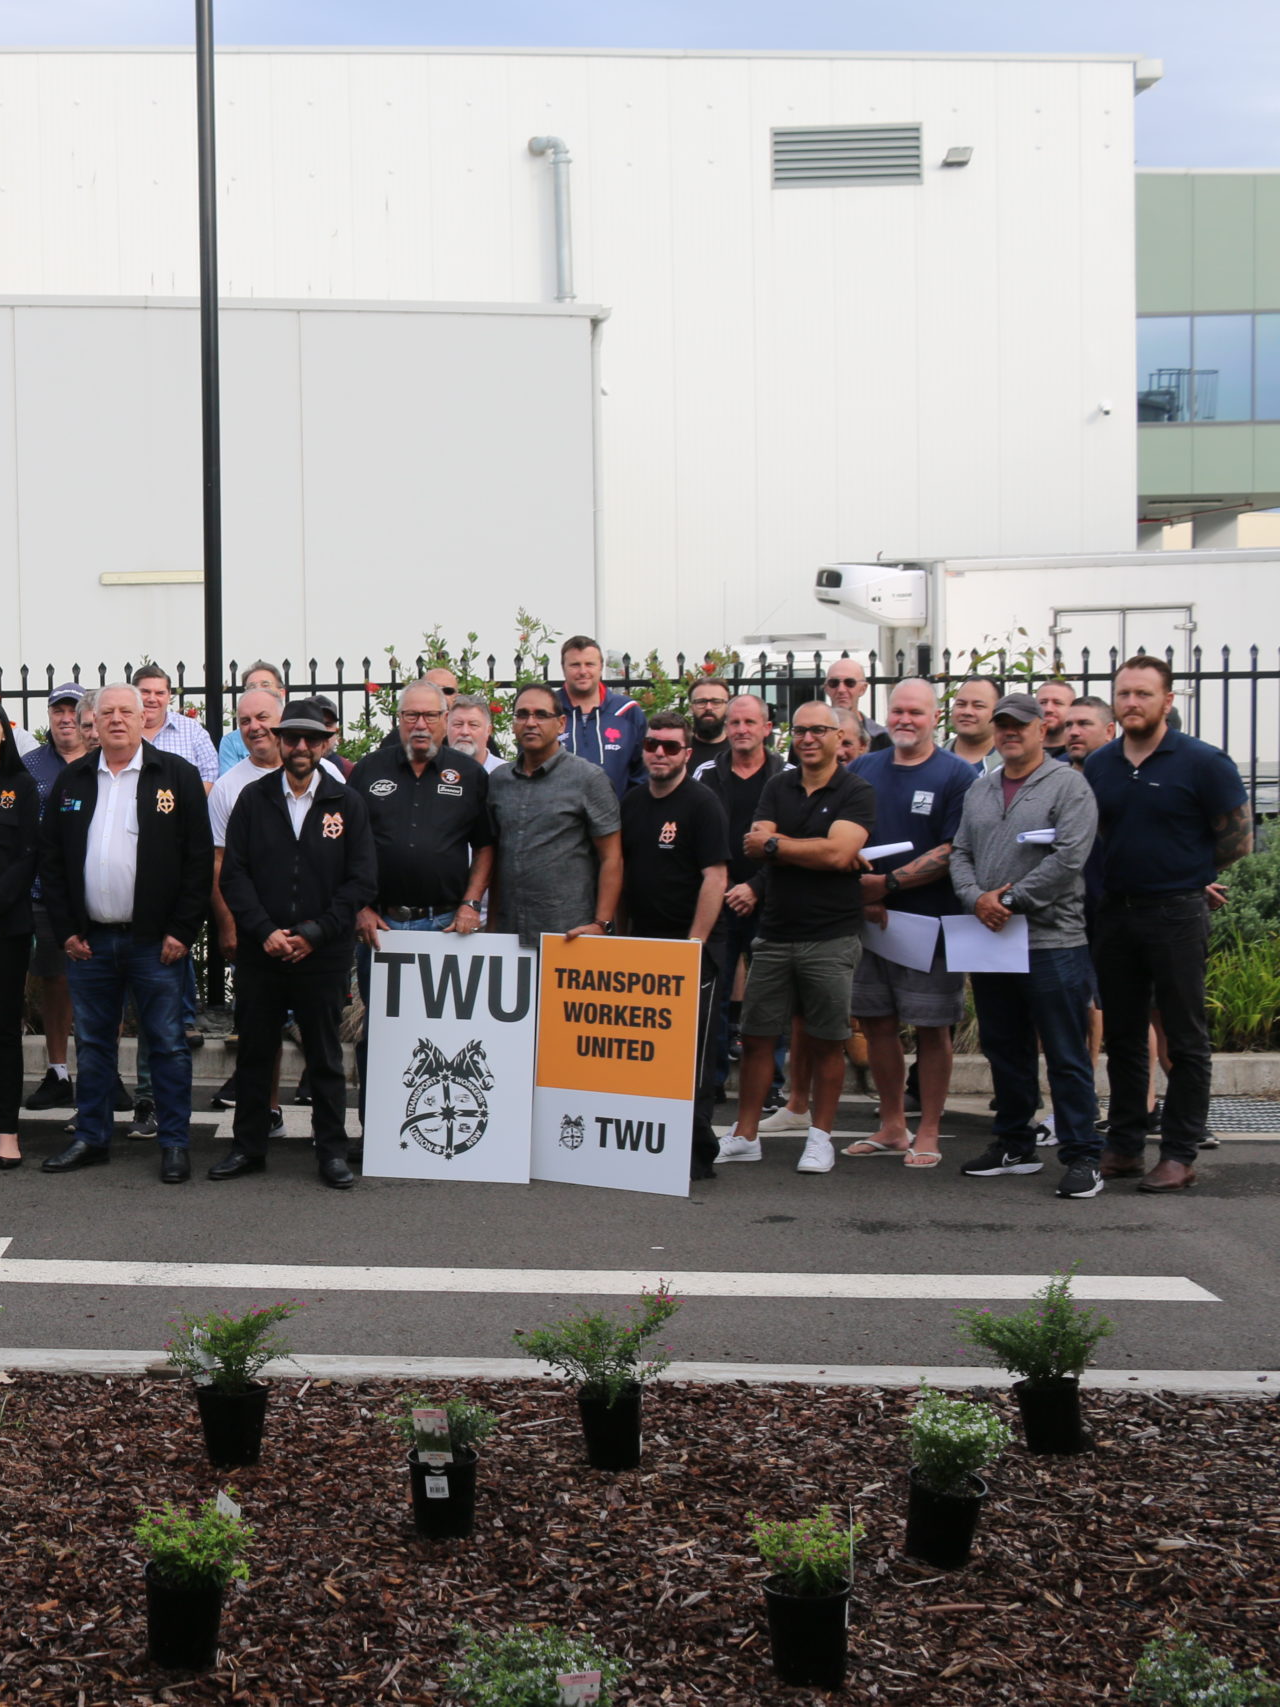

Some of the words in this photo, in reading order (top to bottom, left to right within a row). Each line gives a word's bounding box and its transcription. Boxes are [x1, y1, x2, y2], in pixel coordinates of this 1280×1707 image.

[374, 952, 531, 1022] TWU
[554, 967, 685, 997] TRANSPORT
[563, 1000, 672, 1030] WORKERS
[576, 1034, 655, 1062] UNITED
[407, 1076, 438, 1116] TRANSPORT
[410, 1127, 434, 1151] UNION
[465, 1129, 483, 1148] NSW
[594, 1116, 666, 1154] TWU
